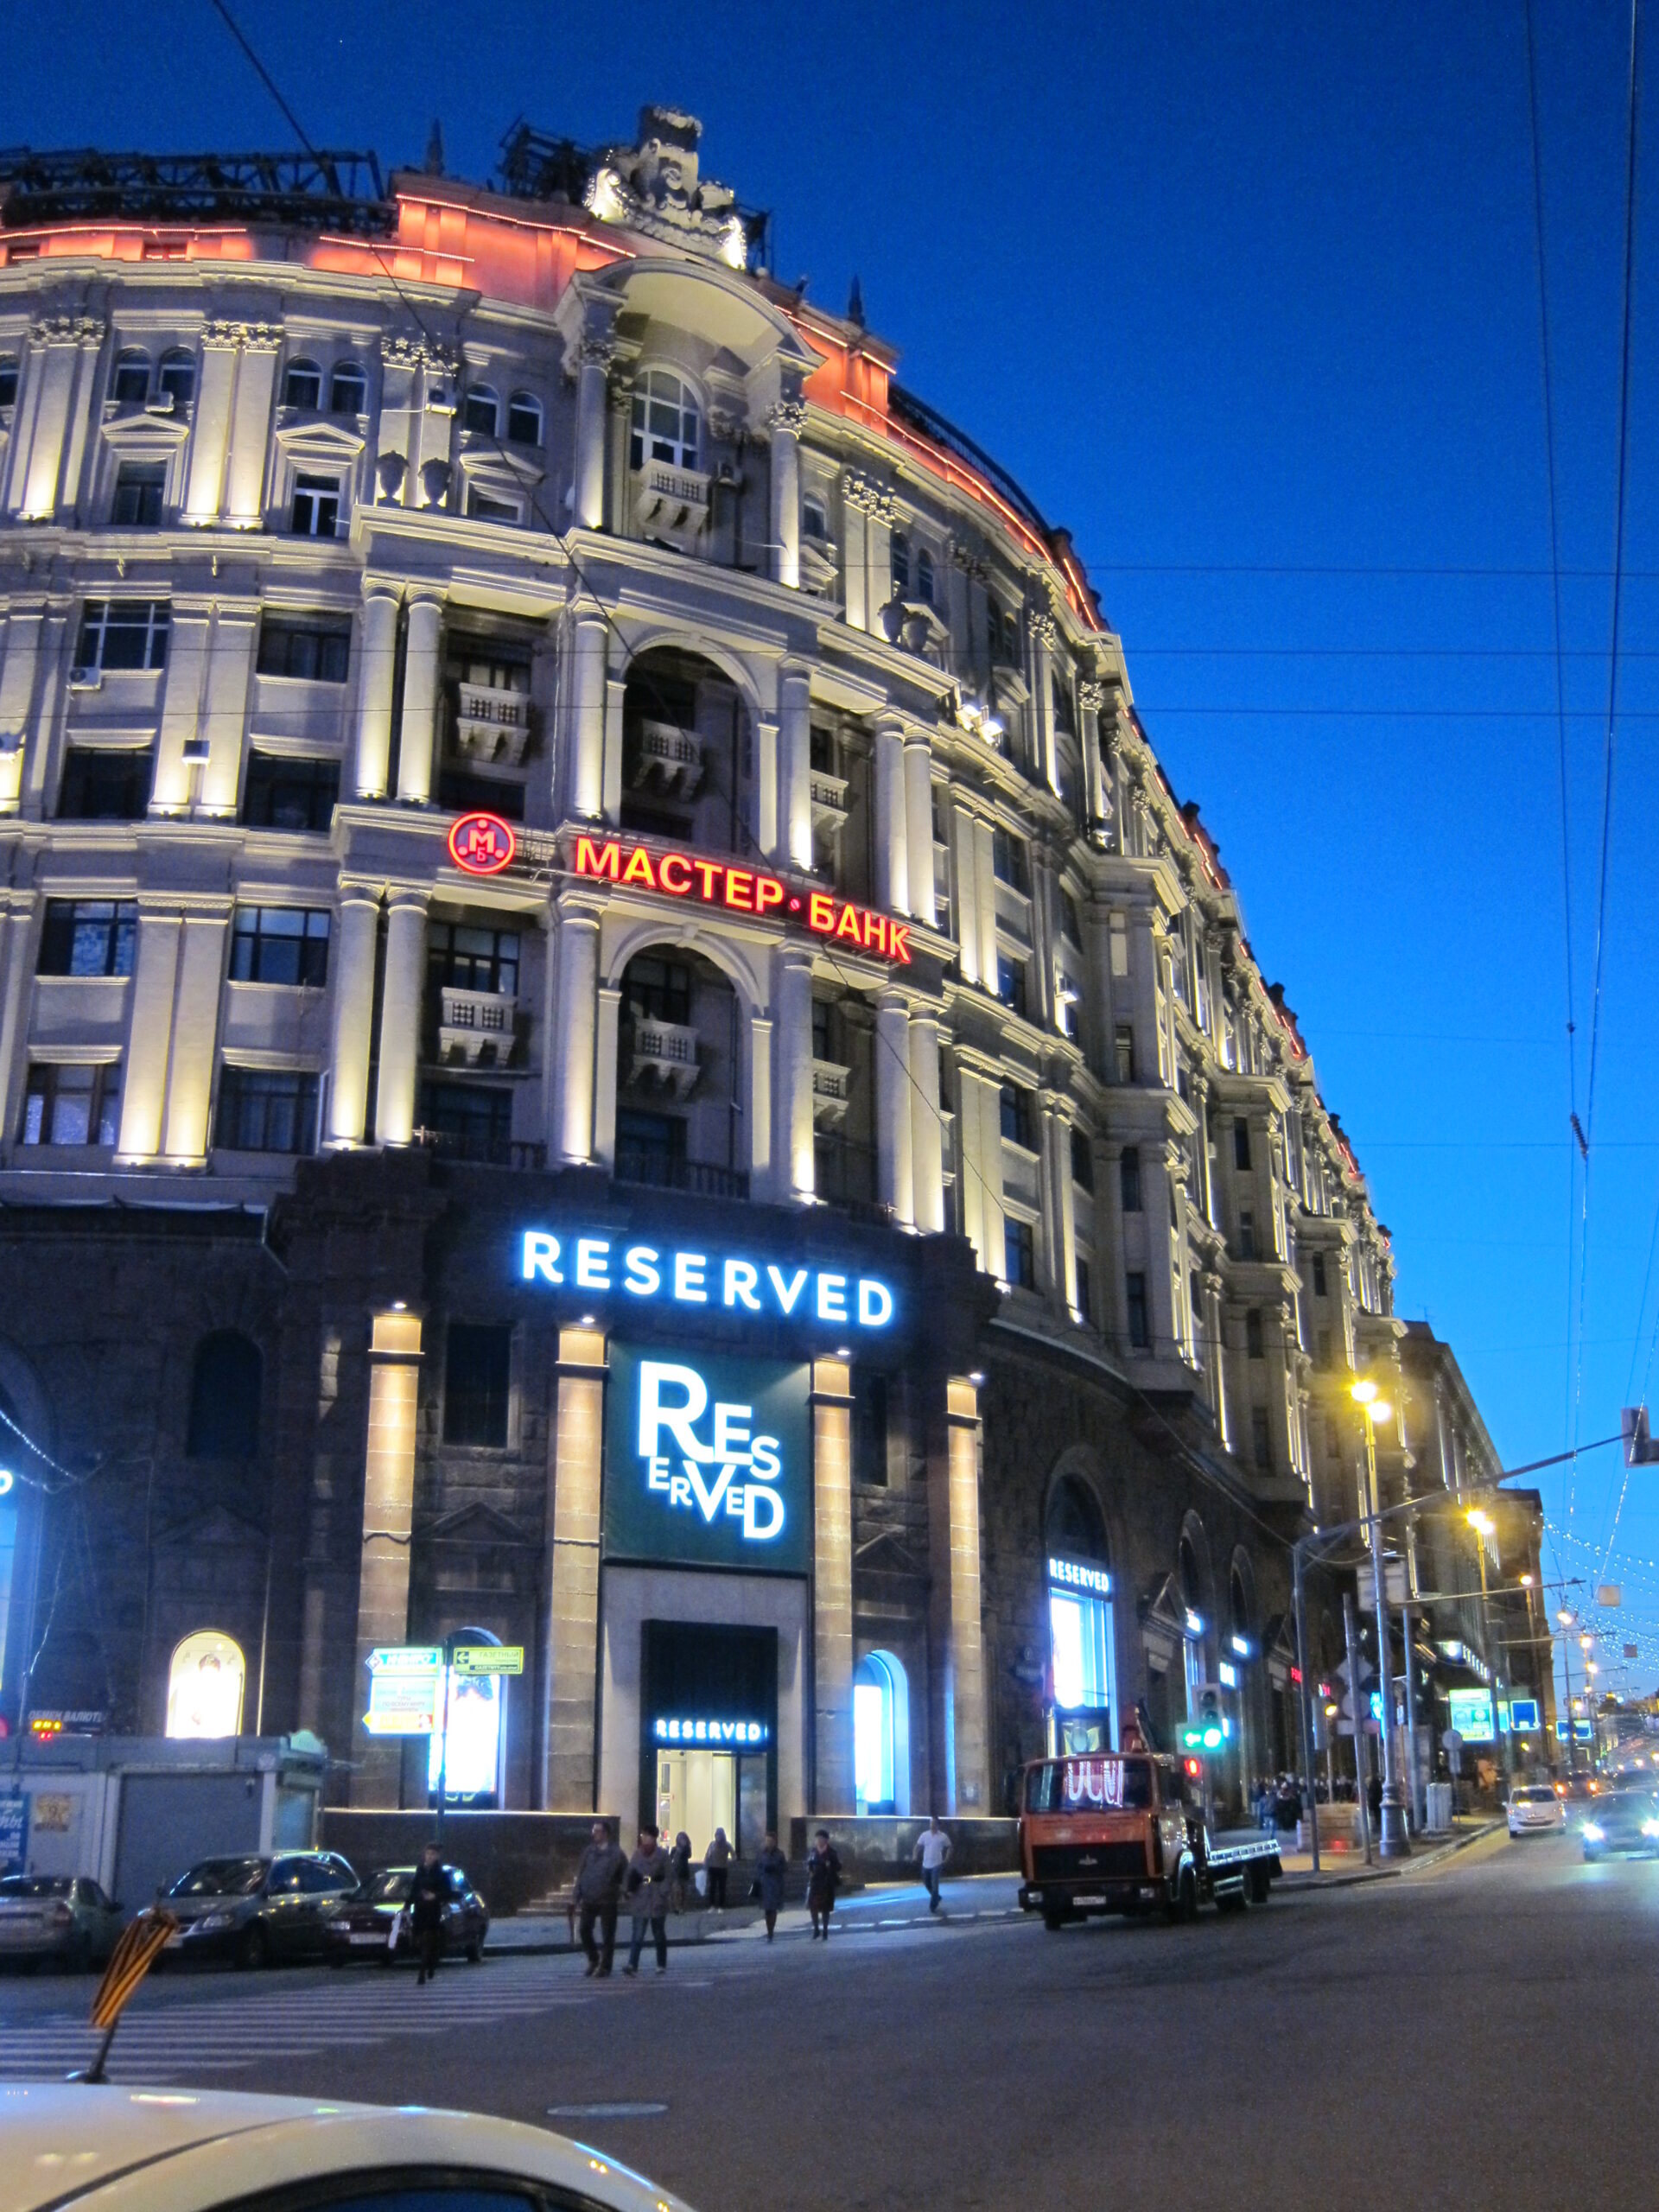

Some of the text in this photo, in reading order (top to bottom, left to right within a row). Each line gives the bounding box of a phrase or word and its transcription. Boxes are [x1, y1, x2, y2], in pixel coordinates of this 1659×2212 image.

[522, 1231, 893, 1325] RESERVED
[1049, 1558, 1109, 1592] RESERVED
[657, 1719, 760, 1741] RESERVED
